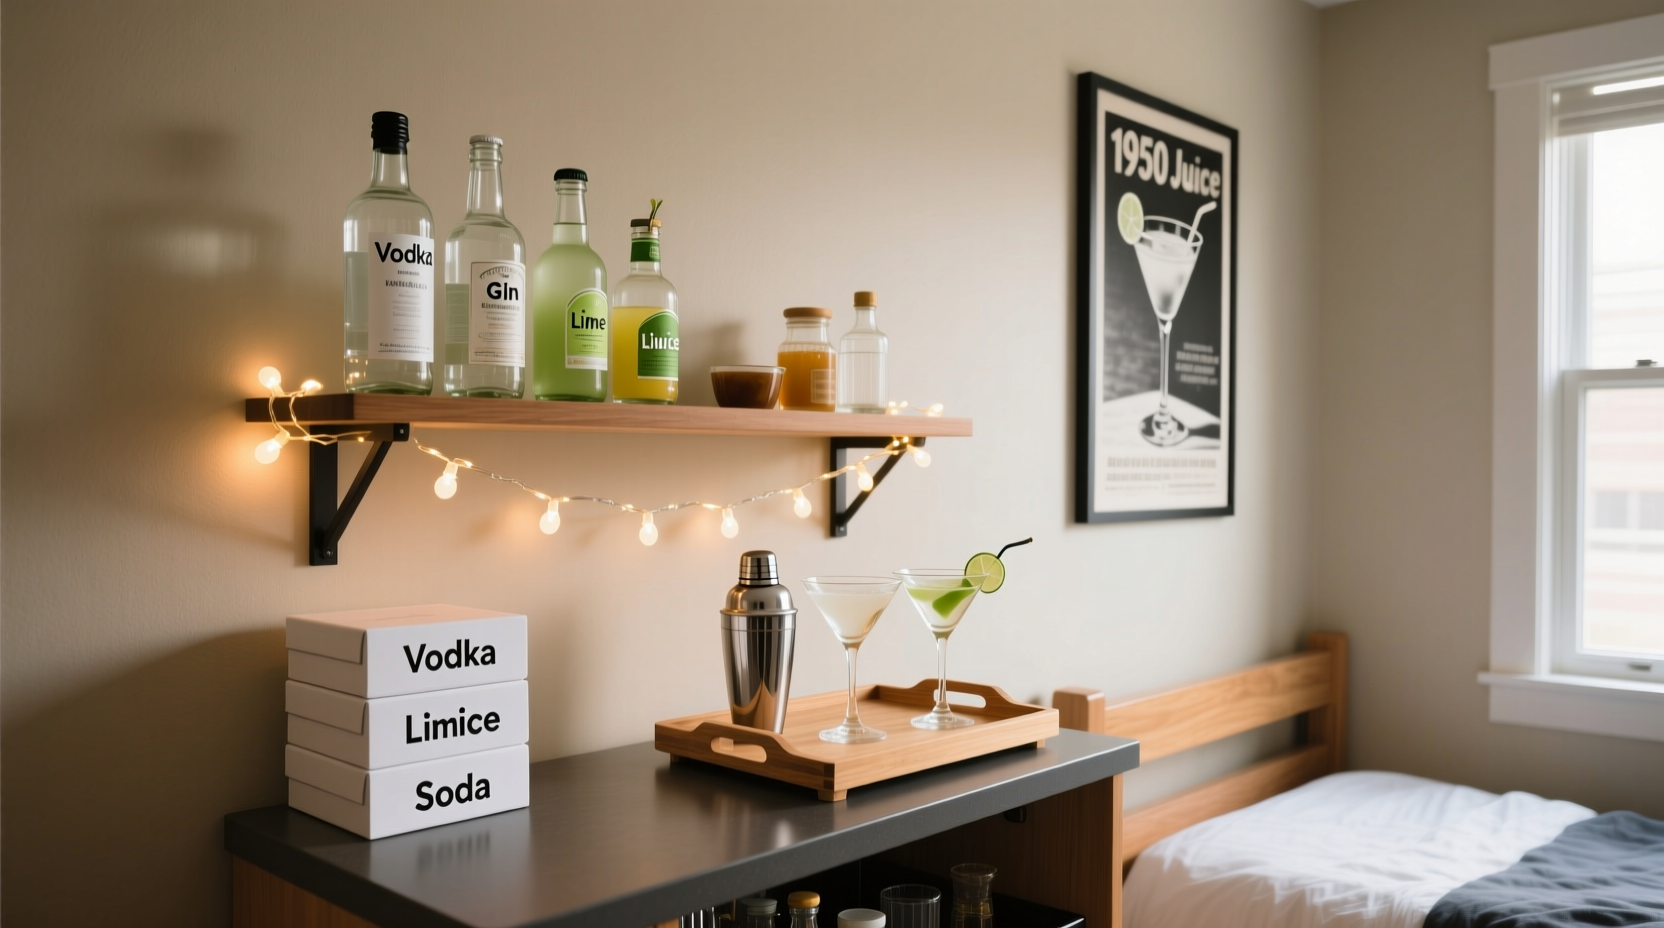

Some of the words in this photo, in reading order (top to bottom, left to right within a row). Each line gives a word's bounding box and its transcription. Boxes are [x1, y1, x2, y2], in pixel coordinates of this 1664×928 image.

[1110, 127, 1169, 186] 1950
[1169, 148, 1221, 199] Juice
[374, 241, 433, 267] Vodka
[571, 309, 606, 330] Lime
[403, 639, 496, 673] Vodka
[405, 707, 501, 745] Limice
[415, 773, 491, 812] Soda
